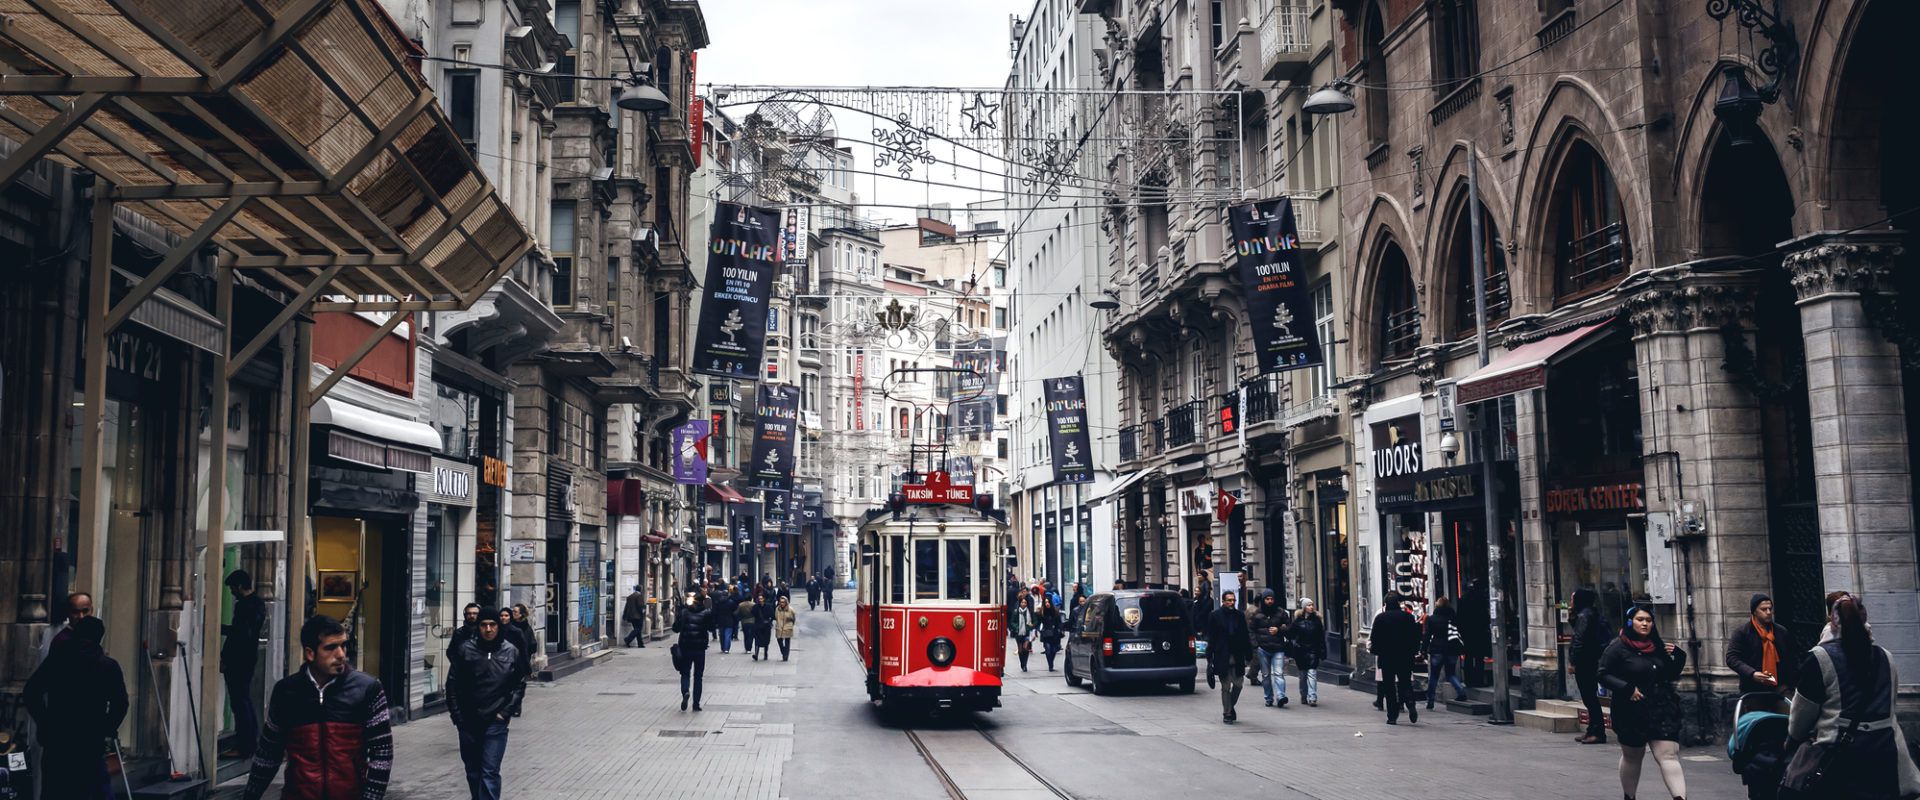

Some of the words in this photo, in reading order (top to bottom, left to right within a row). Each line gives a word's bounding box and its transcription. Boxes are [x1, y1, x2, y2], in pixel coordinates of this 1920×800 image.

[722, 267, 737, 278] 100
[737, 268, 758, 282] YILIN
[1255, 264, 1270, 276] 100
[1270, 261, 1290, 274] YILIN
[726, 286, 748, 294] DRAMA
[714, 291, 733, 300] ERKEK
[733, 293, 759, 304] OYUNCU
[1371, 442, 1419, 478] TUDORS
[935, 471, 941, 483] 2
[945, 488, 970, 500] TÜNEL
[1590, 483, 1643, 509] CENTER
[883, 617, 895, 630] 223
